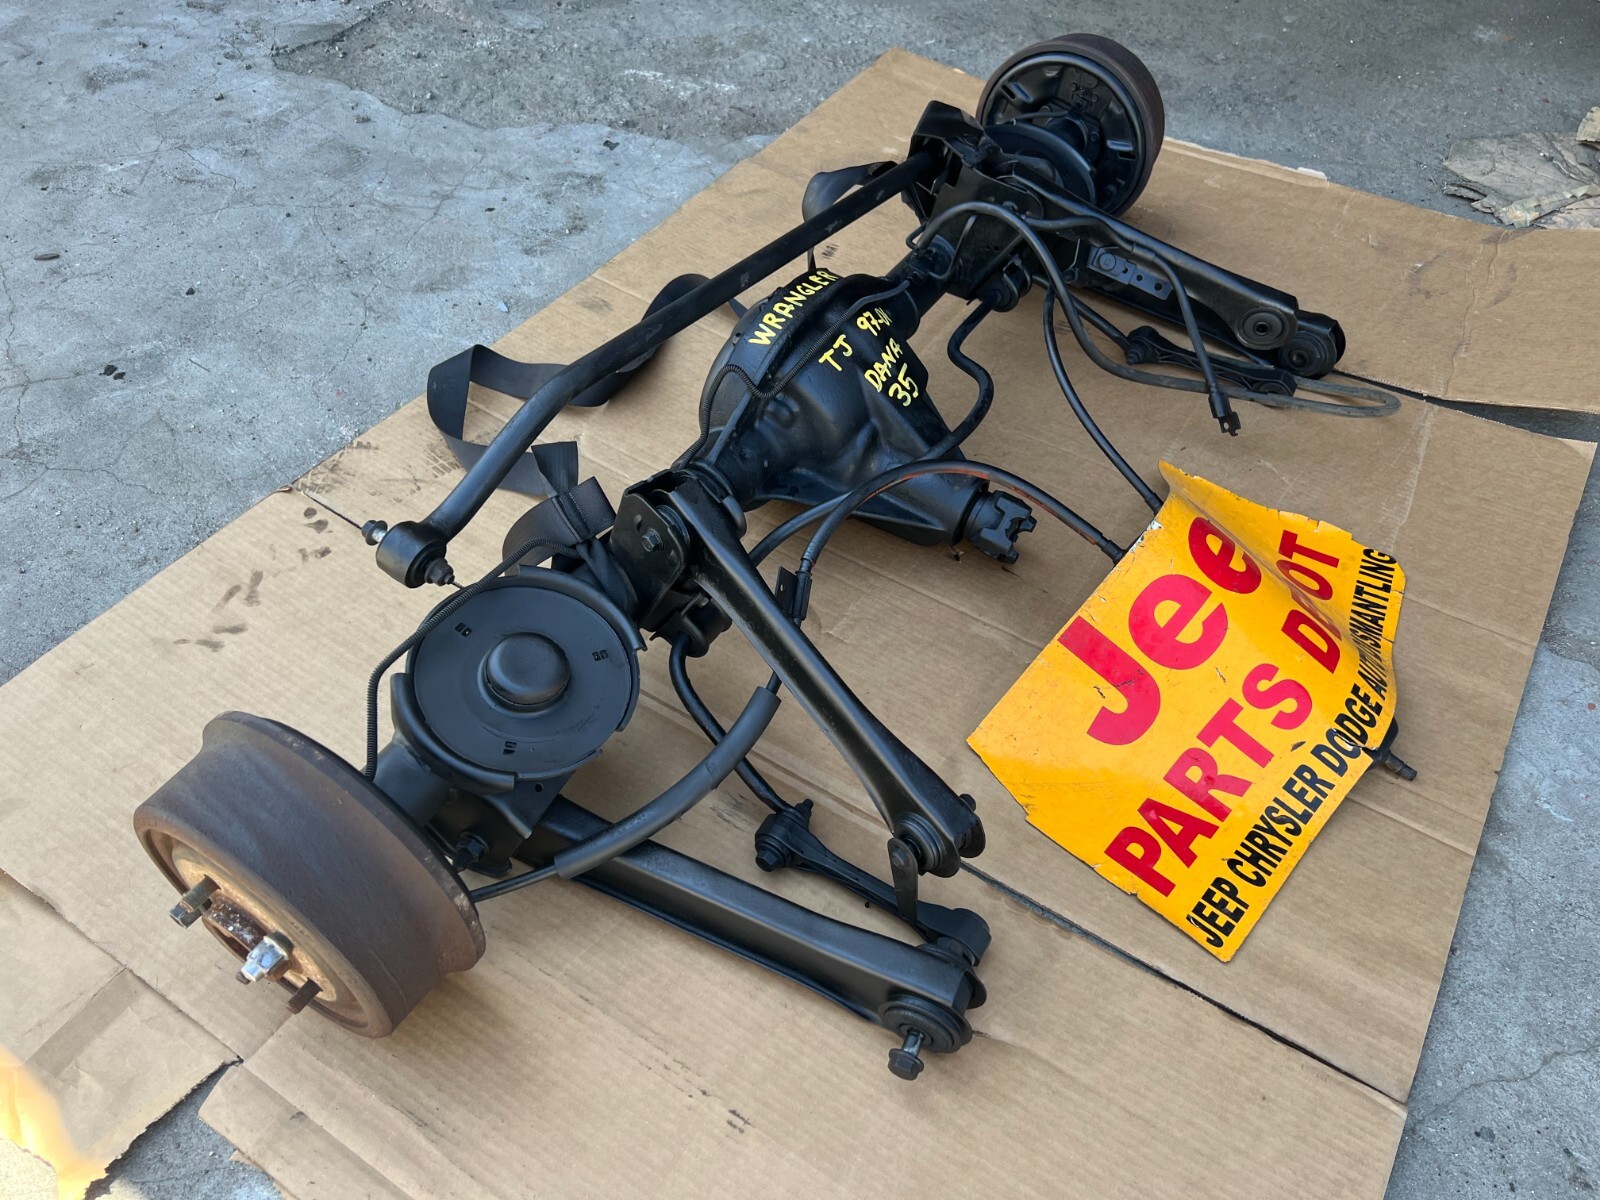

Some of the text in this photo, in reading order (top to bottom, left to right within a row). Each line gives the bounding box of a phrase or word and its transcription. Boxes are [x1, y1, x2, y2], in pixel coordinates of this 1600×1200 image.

[748, 269, 840, 346] WRANGLER
[818, 334, 853, 372] TJ
[863, 337, 904, 393] DANA
[887, 362, 920, 407] 35
[1103, 662, 1313, 898] PARTS
[1185, 876, 1250, 948] JEEP
[1227, 763, 1336, 888] CHRYSLER
[1310, 681, 1383, 778] DODGE
